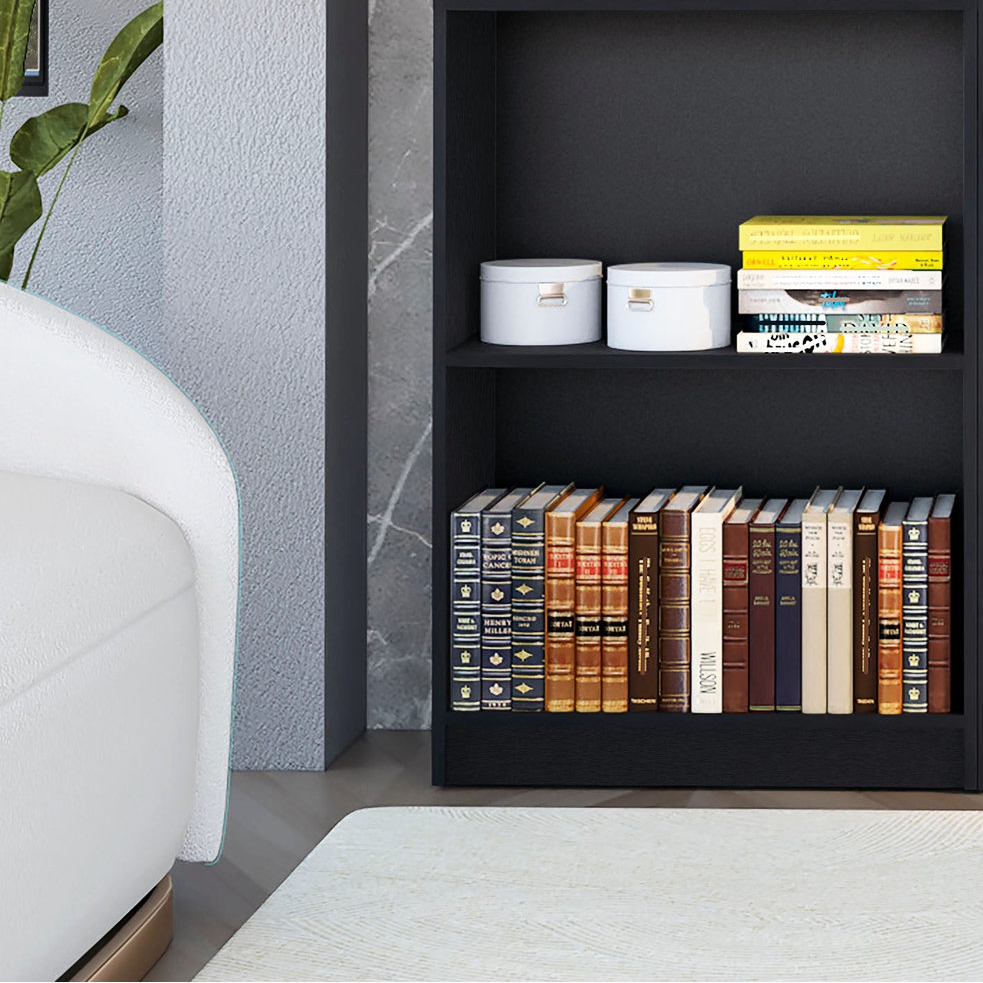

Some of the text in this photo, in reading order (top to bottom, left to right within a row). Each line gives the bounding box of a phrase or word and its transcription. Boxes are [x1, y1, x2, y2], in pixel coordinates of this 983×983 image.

[699, 527, 716, 553] EGGS
[699, 569, 716, 593] HAVE
[699, 652, 717, 694] WILLSON
